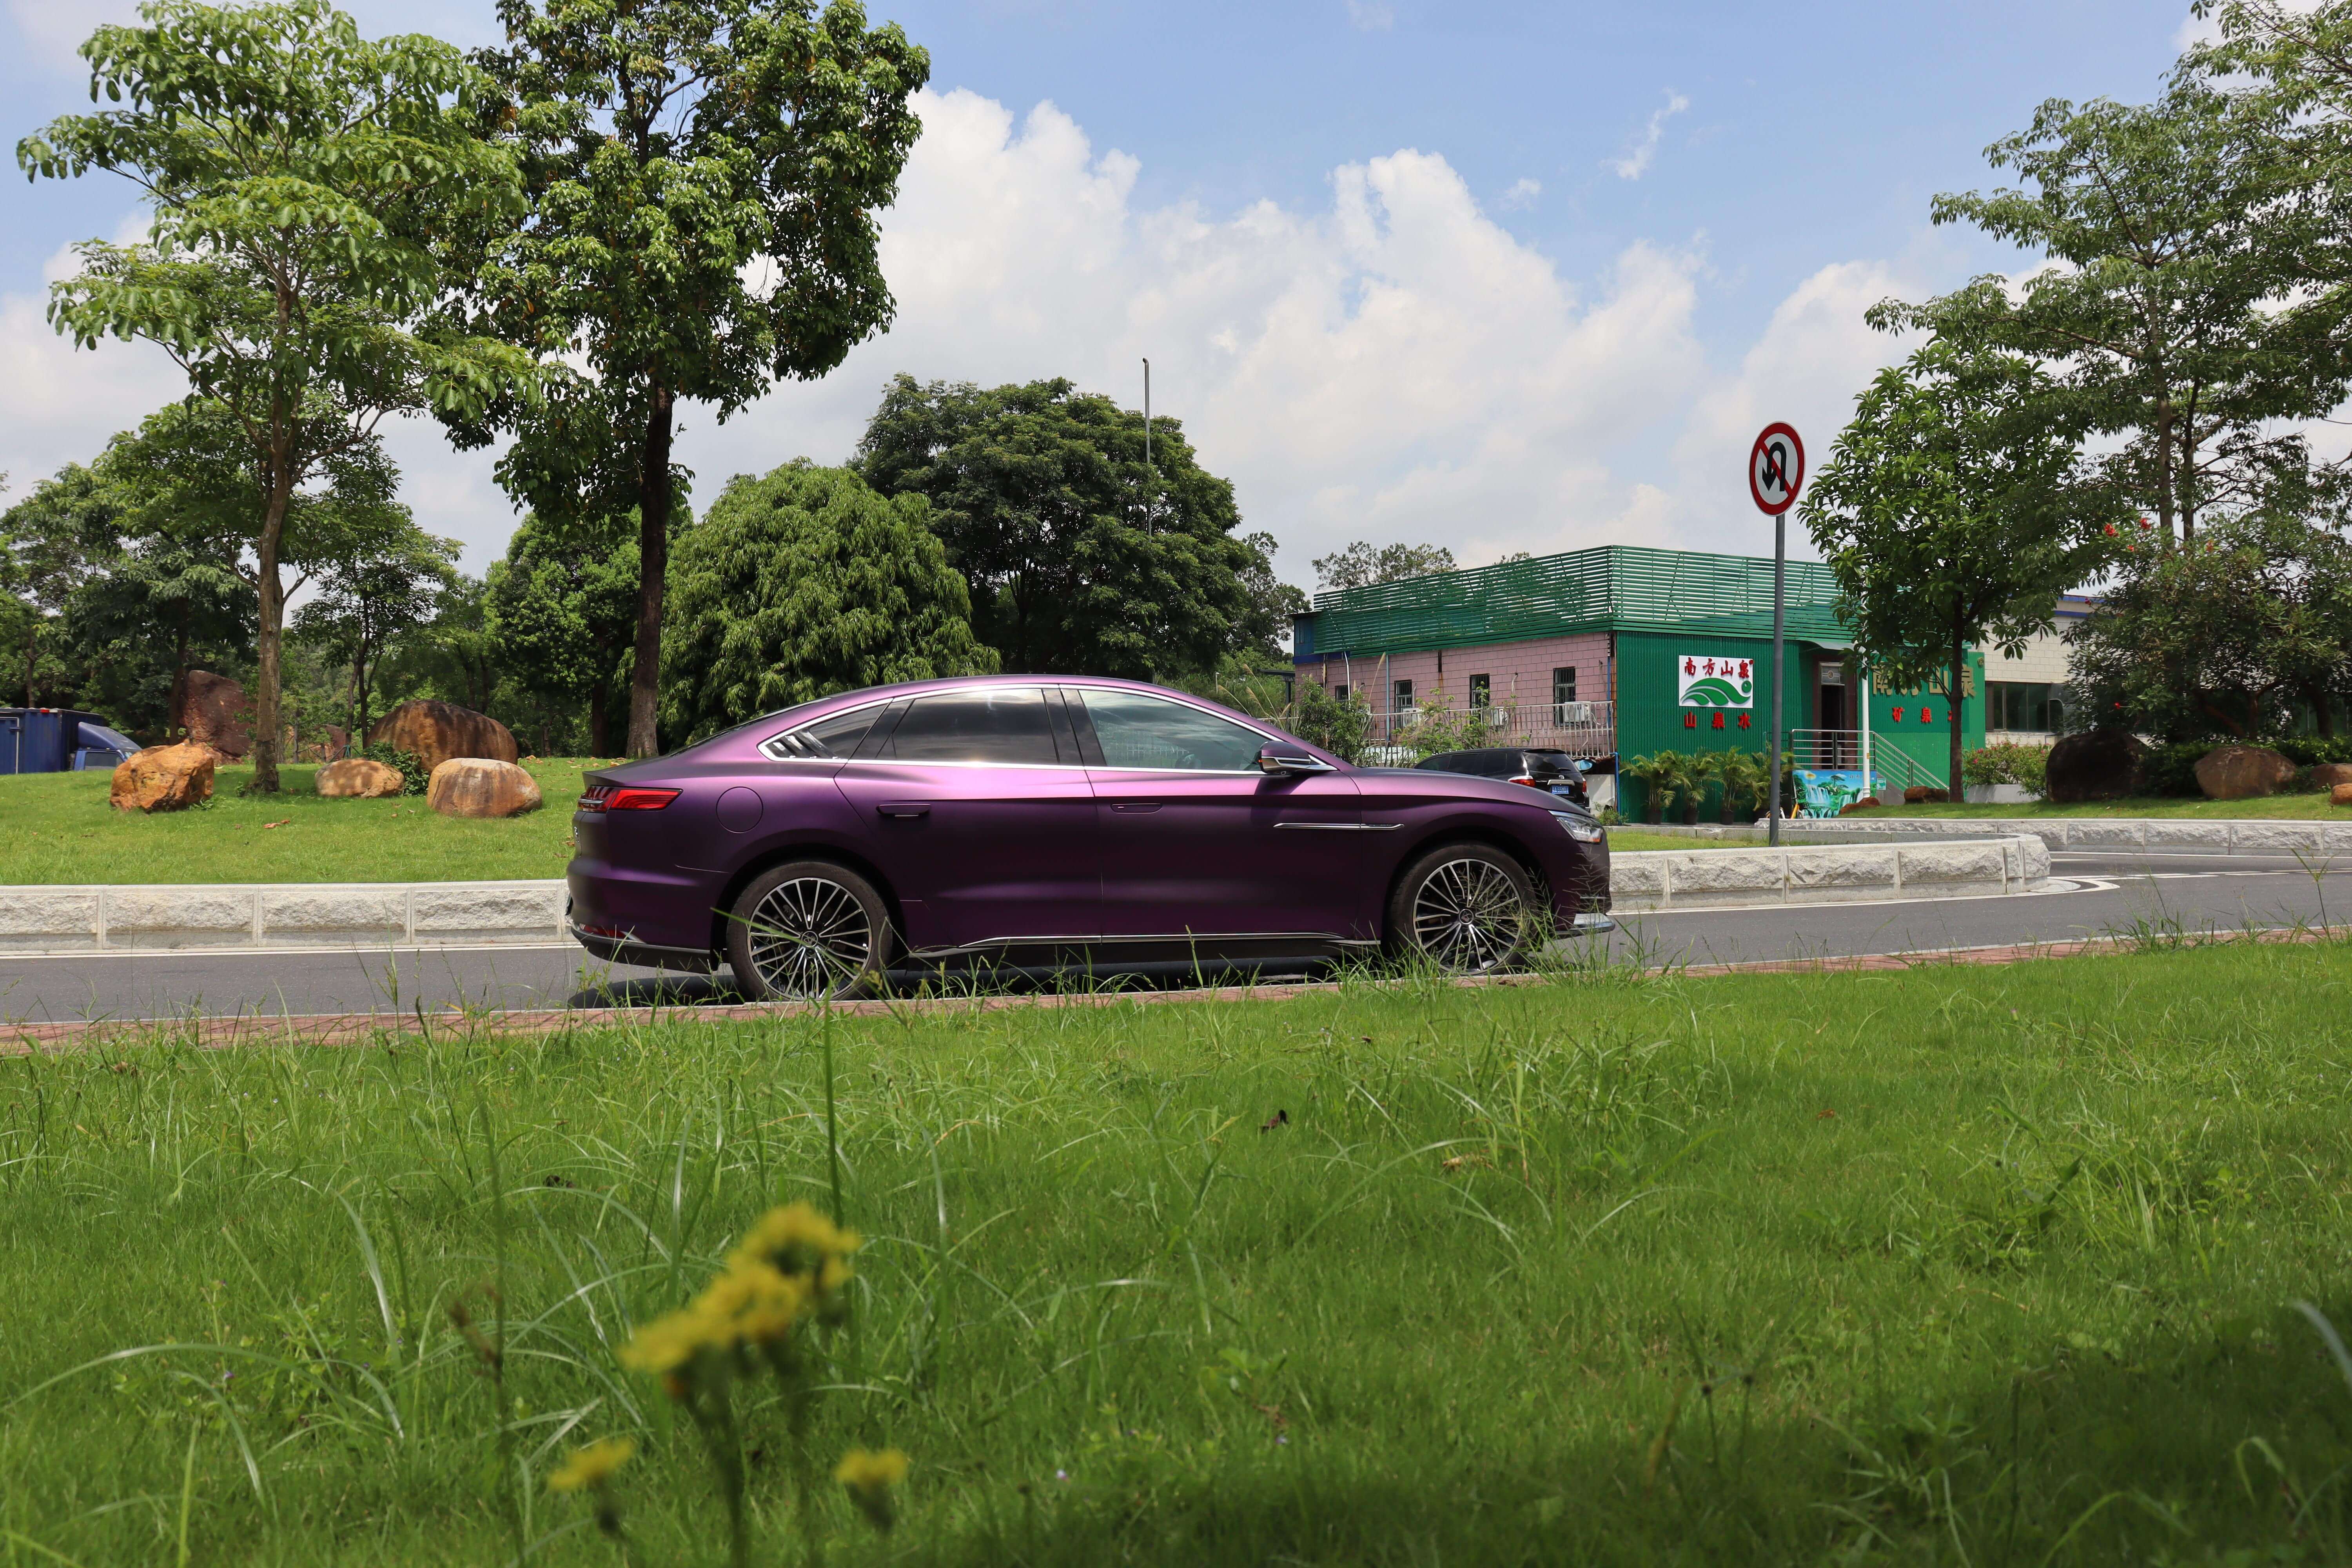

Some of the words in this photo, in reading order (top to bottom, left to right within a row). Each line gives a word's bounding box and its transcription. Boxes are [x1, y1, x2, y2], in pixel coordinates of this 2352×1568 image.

[1684, 657, 1749, 678] 南方山泉
[1872, 665, 1976, 697] 南山泉
[1684, 711, 1751, 729] 山泉水
[1892, 707, 1953, 722] 矿泉
